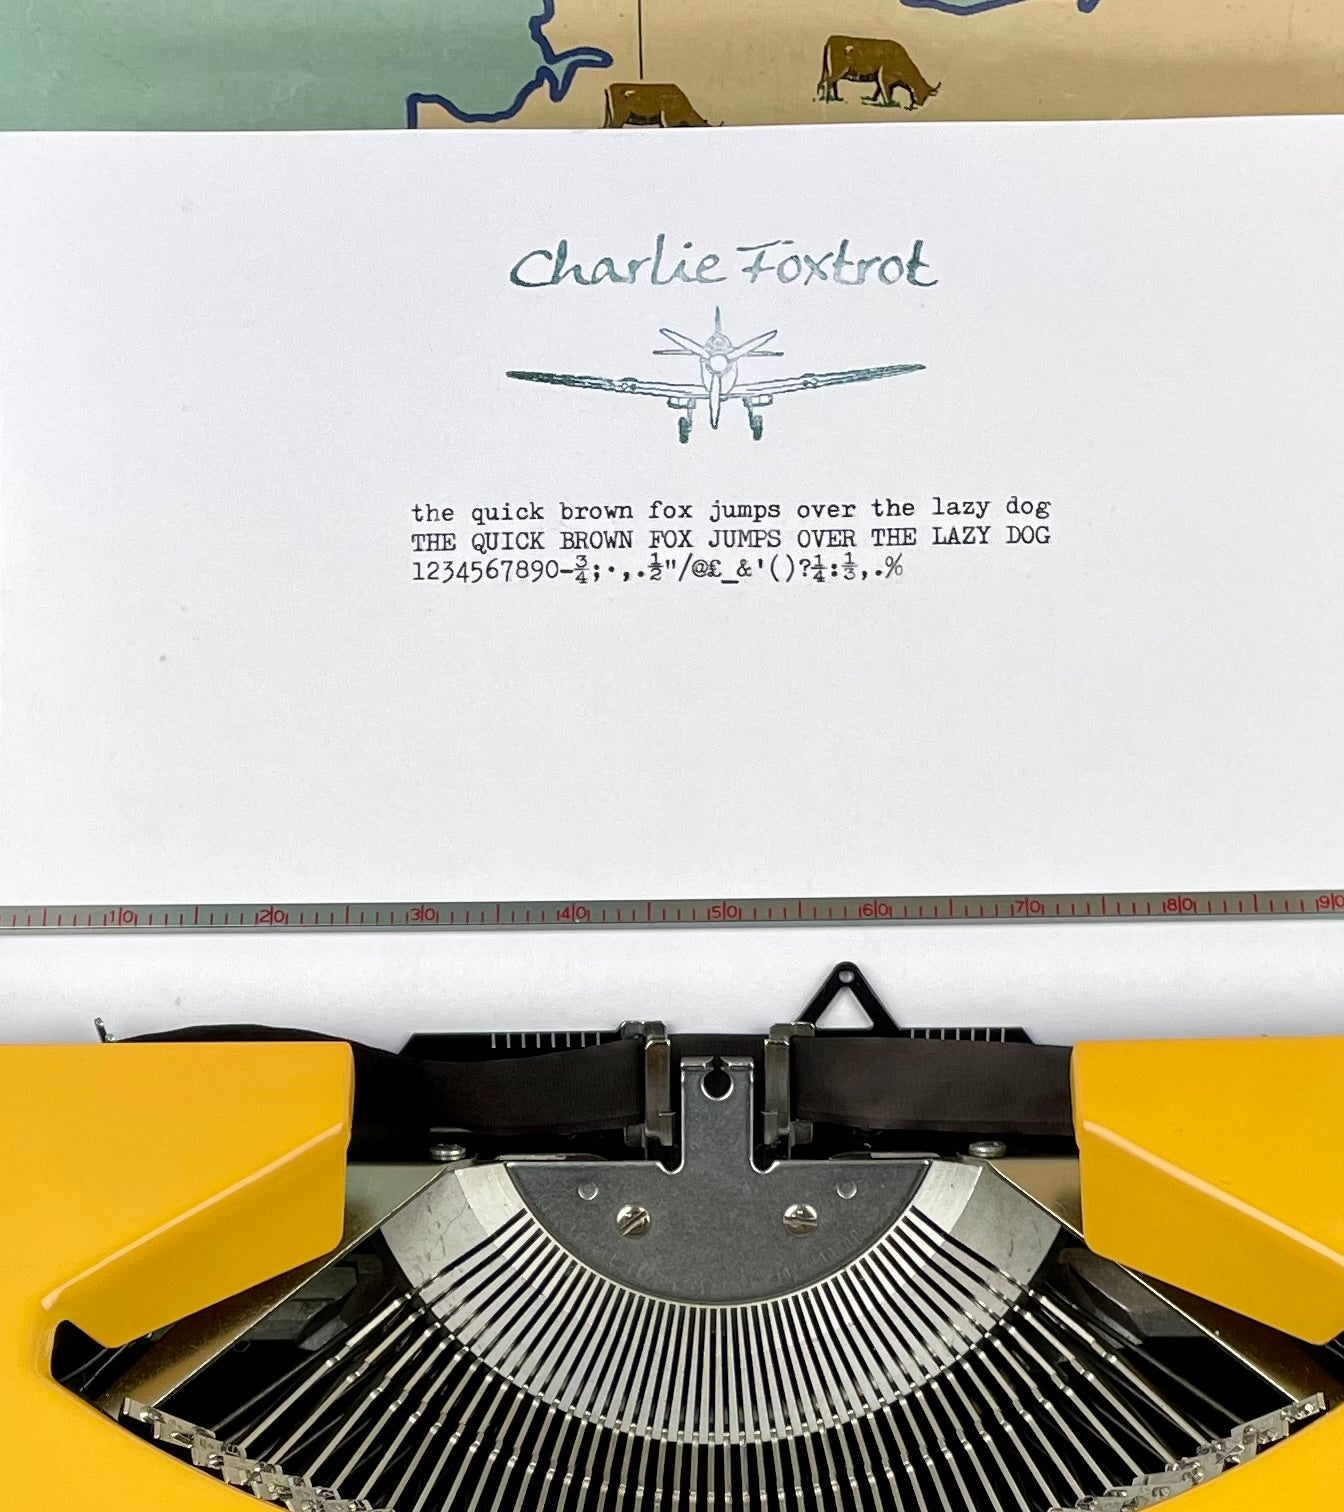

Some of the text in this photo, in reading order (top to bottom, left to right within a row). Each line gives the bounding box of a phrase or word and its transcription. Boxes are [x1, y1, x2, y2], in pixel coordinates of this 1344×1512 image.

[509, 234, 939, 287] Charlie Foxtrot
[411, 496, 1052, 526] the quick brown fox jumps over the lazy dog
[411, 525, 1052, 554] THE QUICK BROWN FOX JUMPS OVER THE LAZY DOG
